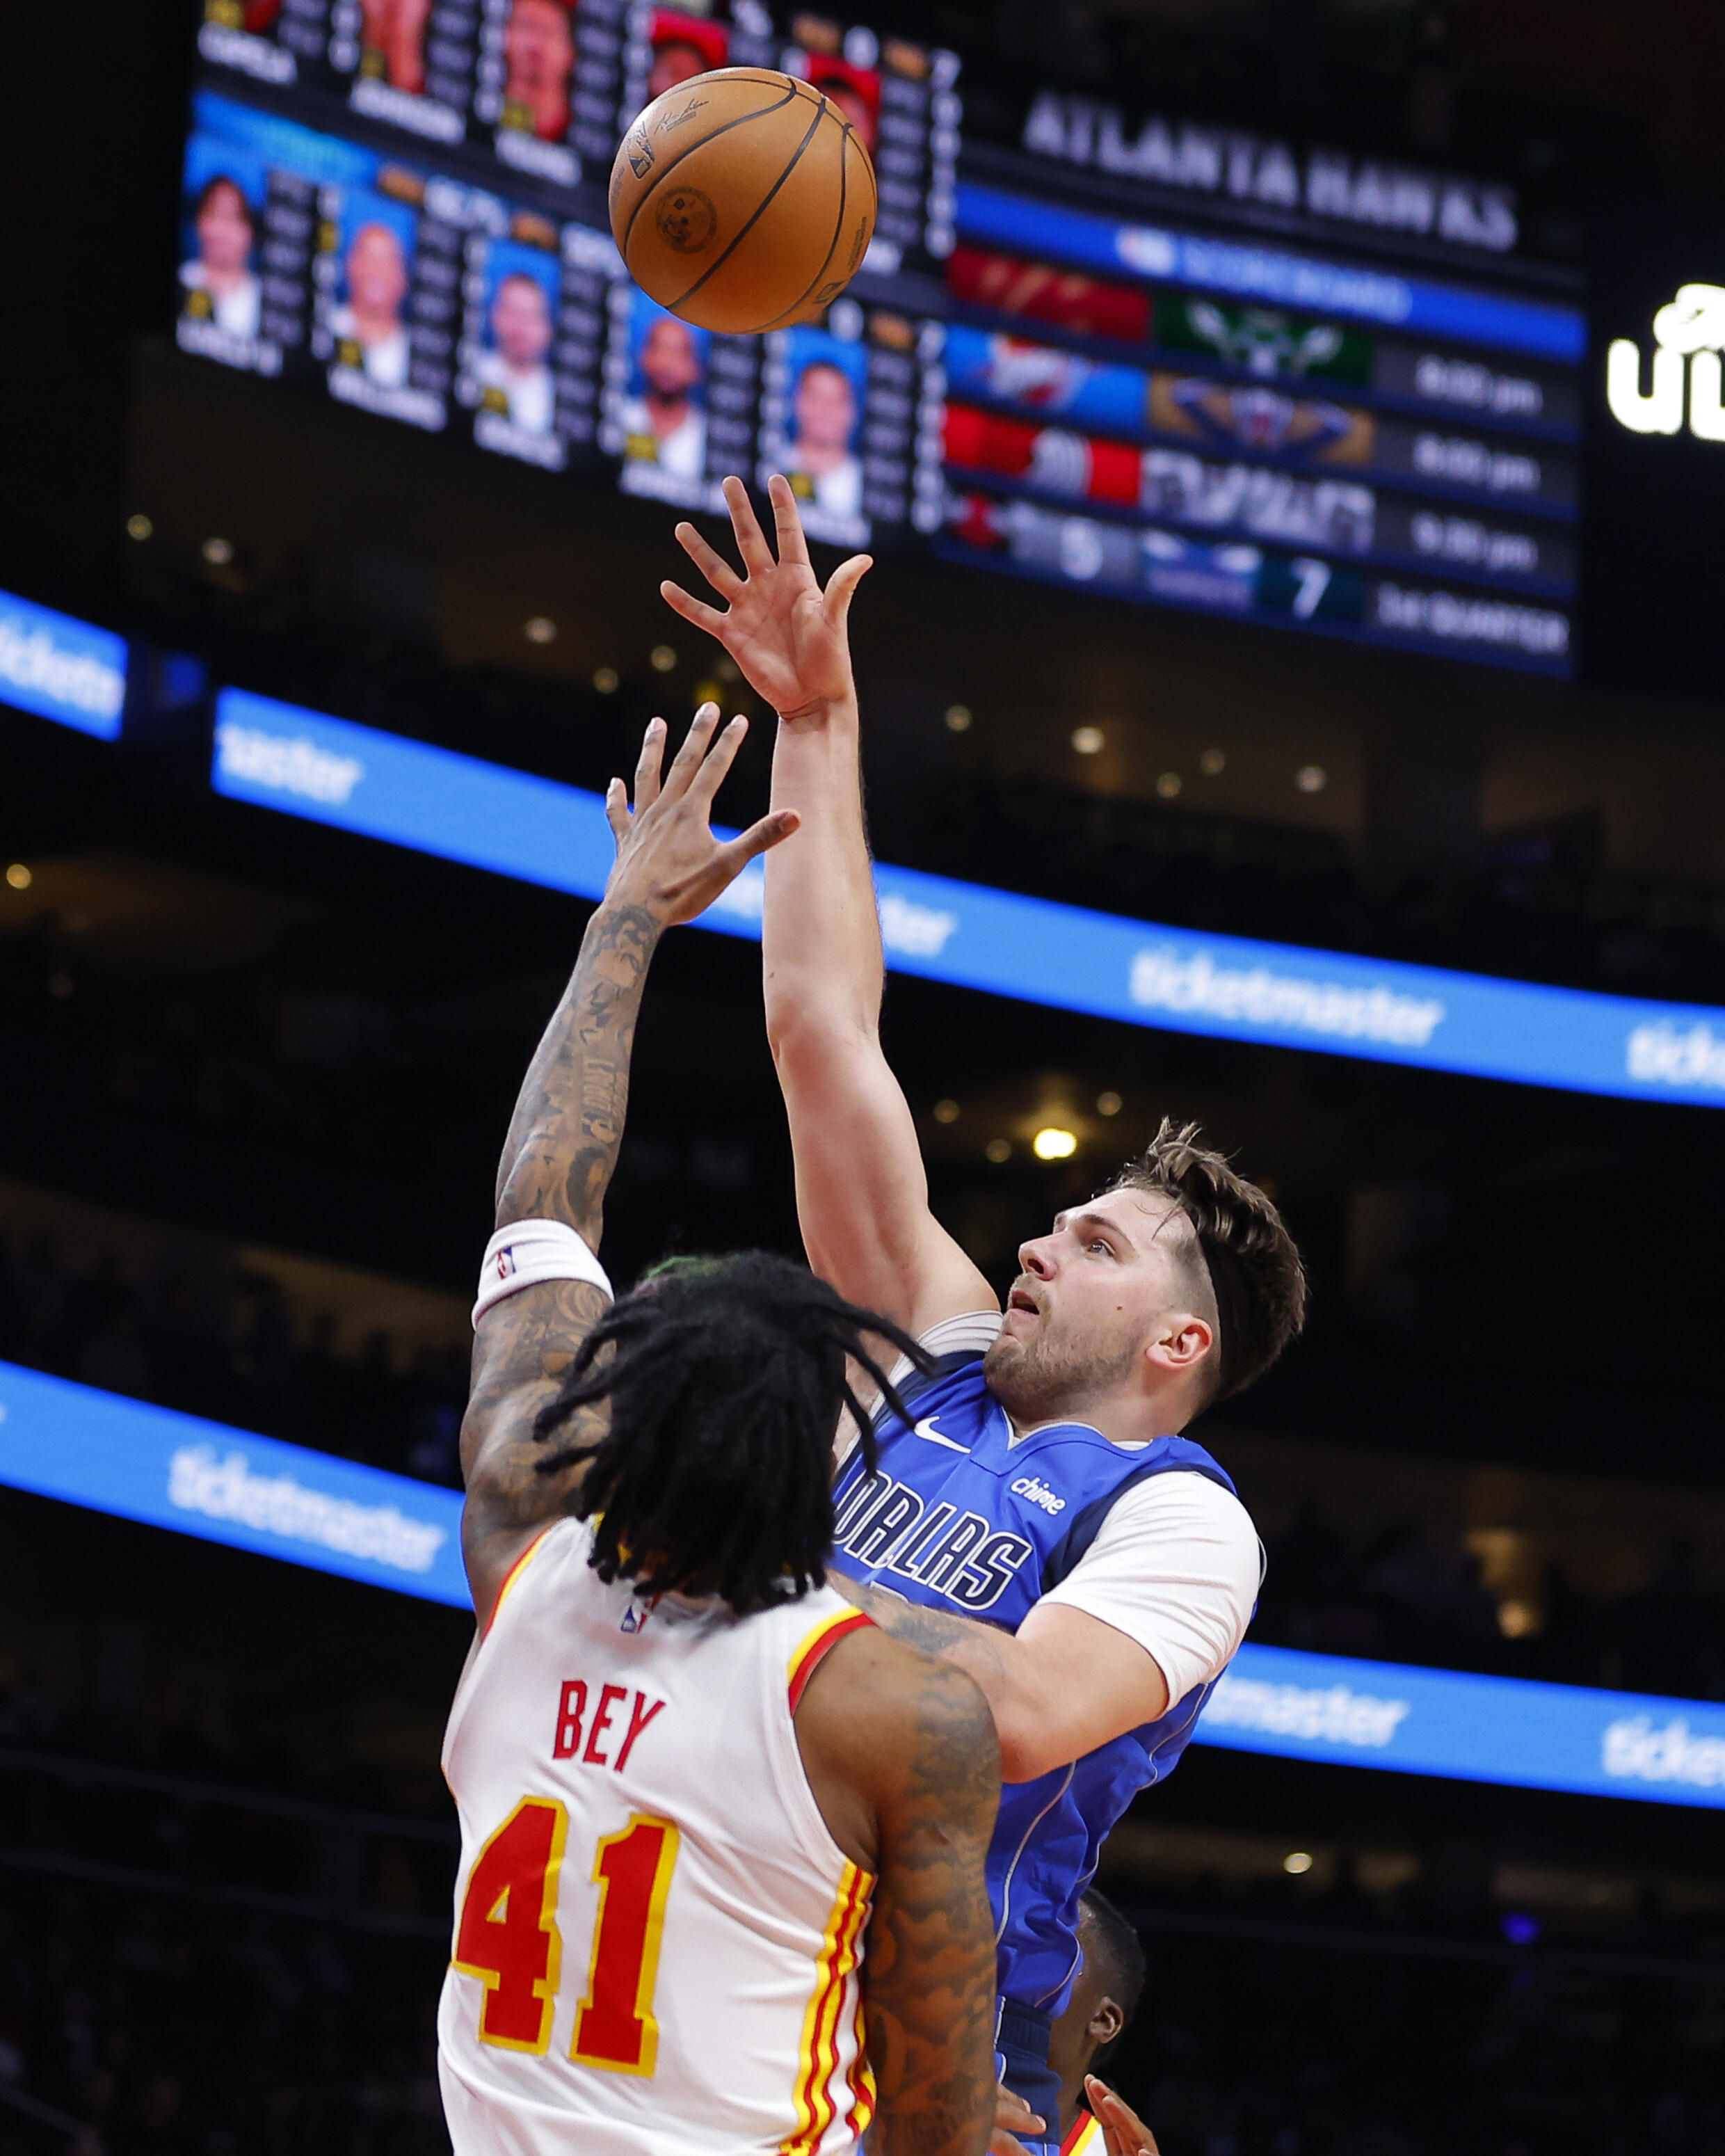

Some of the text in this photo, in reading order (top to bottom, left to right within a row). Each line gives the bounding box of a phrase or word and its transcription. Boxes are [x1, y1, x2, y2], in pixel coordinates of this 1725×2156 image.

[1025, 92, 1299, 207] ATLANTA
[1305, 147, 1519, 252] HAWKS
[1130, 945, 1445, 1047] ticketmaster
[1010, 1476, 1067, 1517] chime
[552, 1678, 666, 1774] BEY
[451, 1793, 680, 2078] 41
